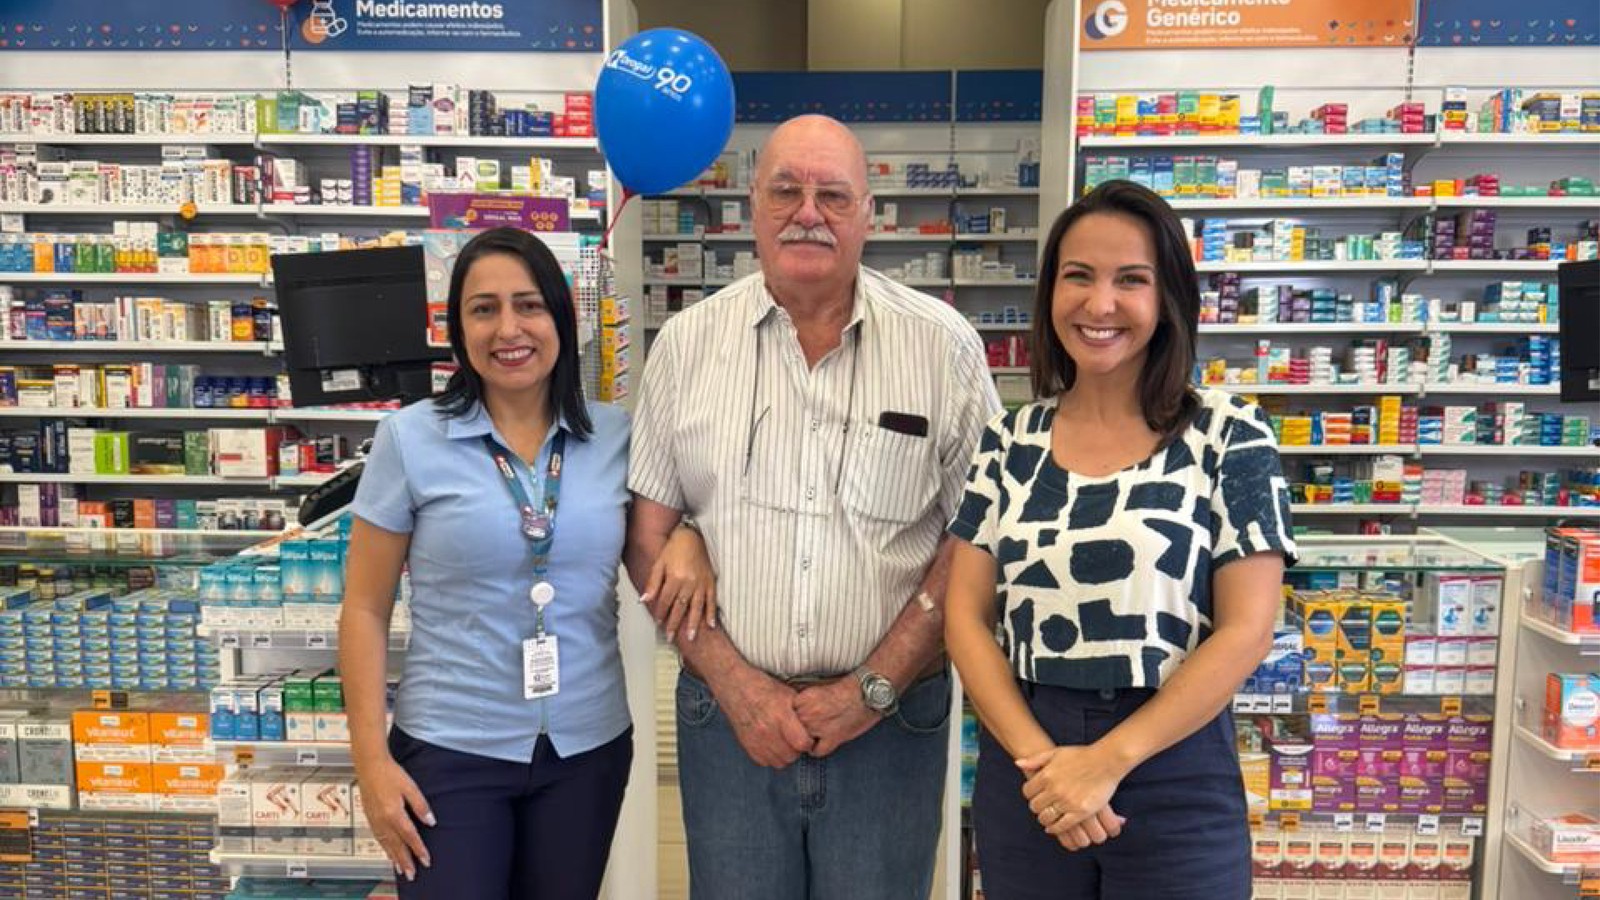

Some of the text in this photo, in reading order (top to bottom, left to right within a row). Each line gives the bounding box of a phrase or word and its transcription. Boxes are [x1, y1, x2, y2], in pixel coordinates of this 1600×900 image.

[356, 0, 504, 18] Medicamentos
[1094, 0, 1129, 37] G
[1147, 7, 1241, 27] Genérico
[655, 67, 692, 92] 90
